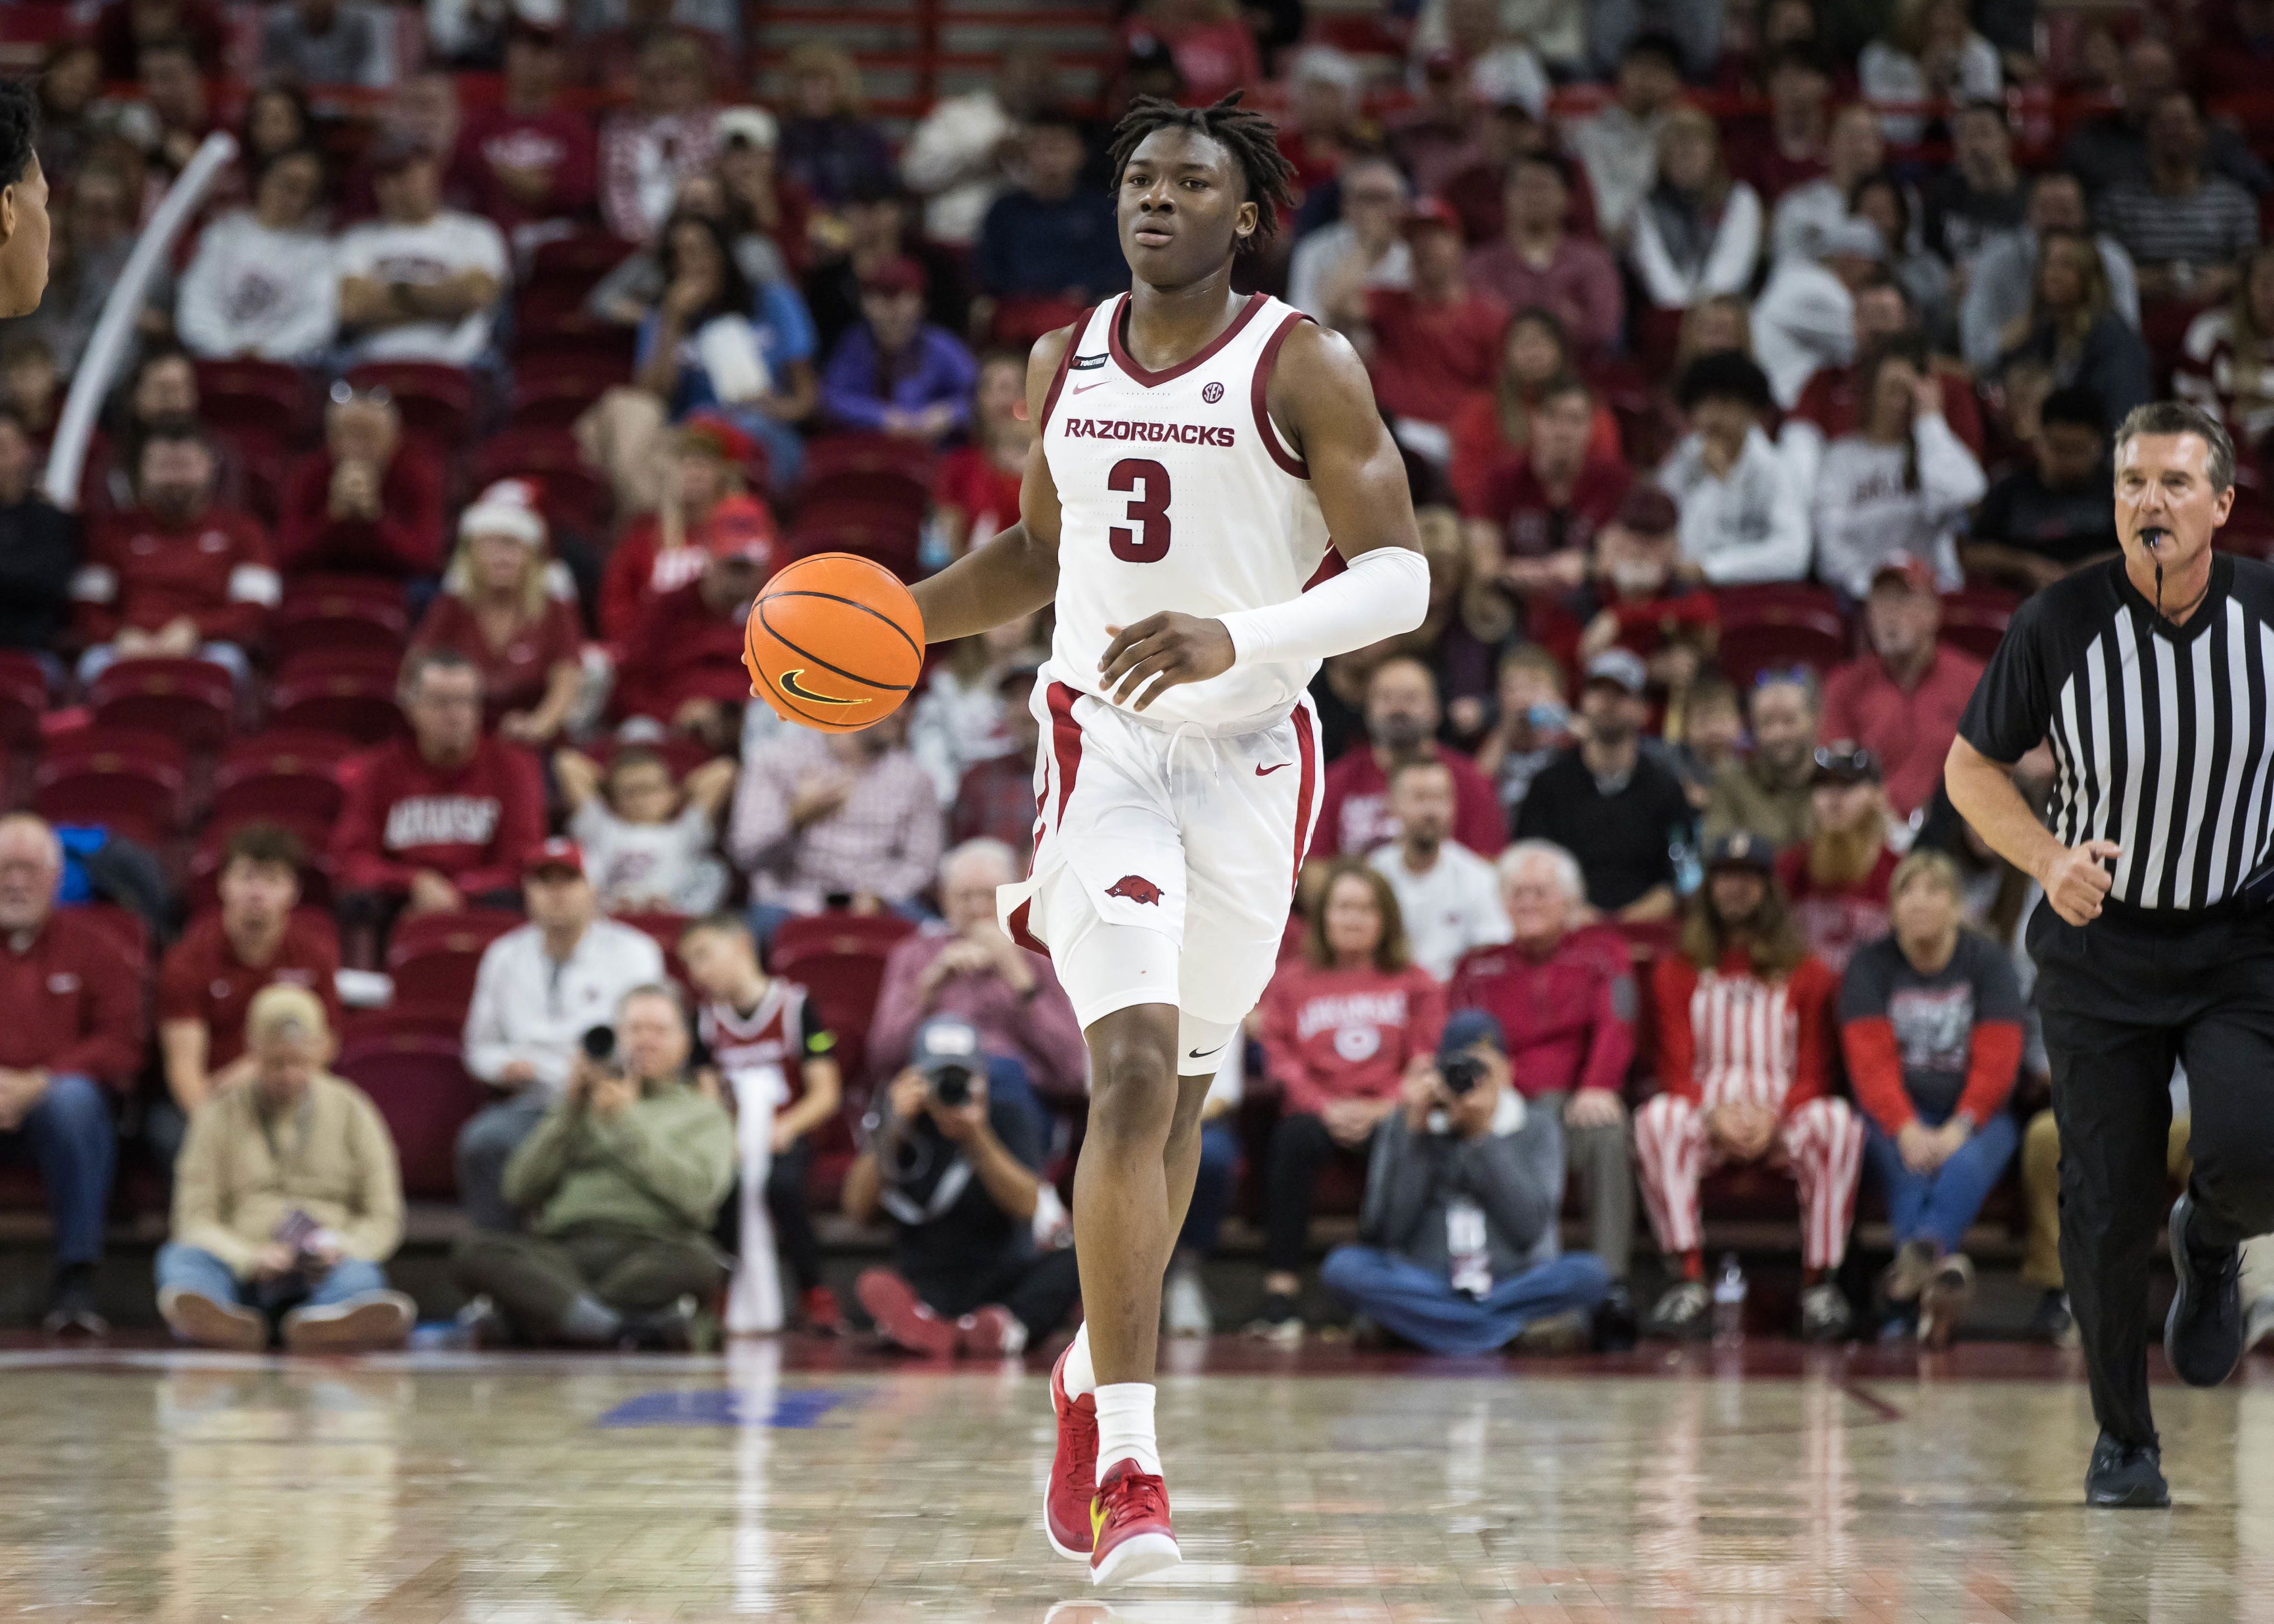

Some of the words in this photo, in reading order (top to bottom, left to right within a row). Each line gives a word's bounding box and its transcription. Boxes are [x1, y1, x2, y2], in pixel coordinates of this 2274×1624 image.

[1080, 356, 1106, 366] TOGETHER
[1203, 383, 1223, 402] SEC
[1064, 418, 1235, 448] RAZORBACKS
[1108, 458, 1171, 563] 3
